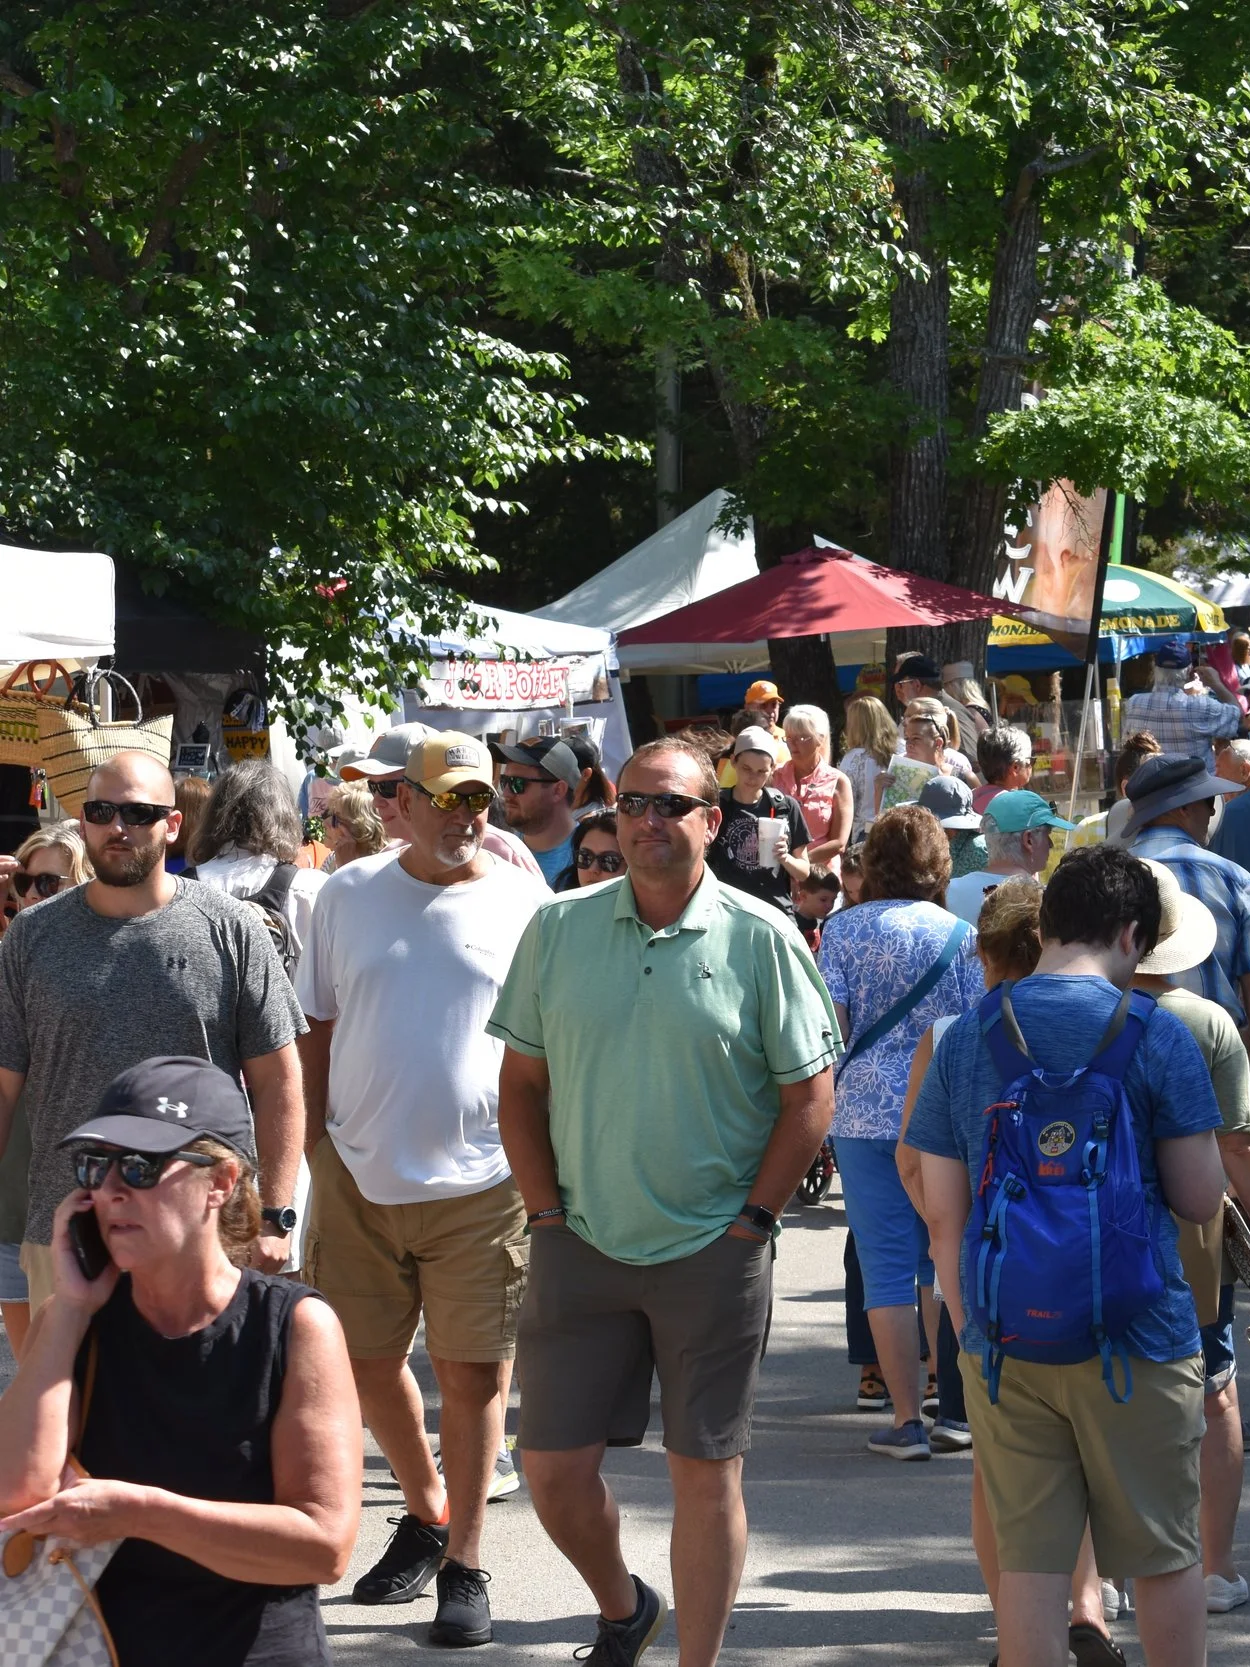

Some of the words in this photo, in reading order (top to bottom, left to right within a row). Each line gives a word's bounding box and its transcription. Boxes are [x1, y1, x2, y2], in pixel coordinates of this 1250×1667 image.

[444, 660, 457, 700] J
[485, 660, 502, 700] R
[503, 660, 568, 707] Pottery
[225, 734, 266, 750] HAPPY
